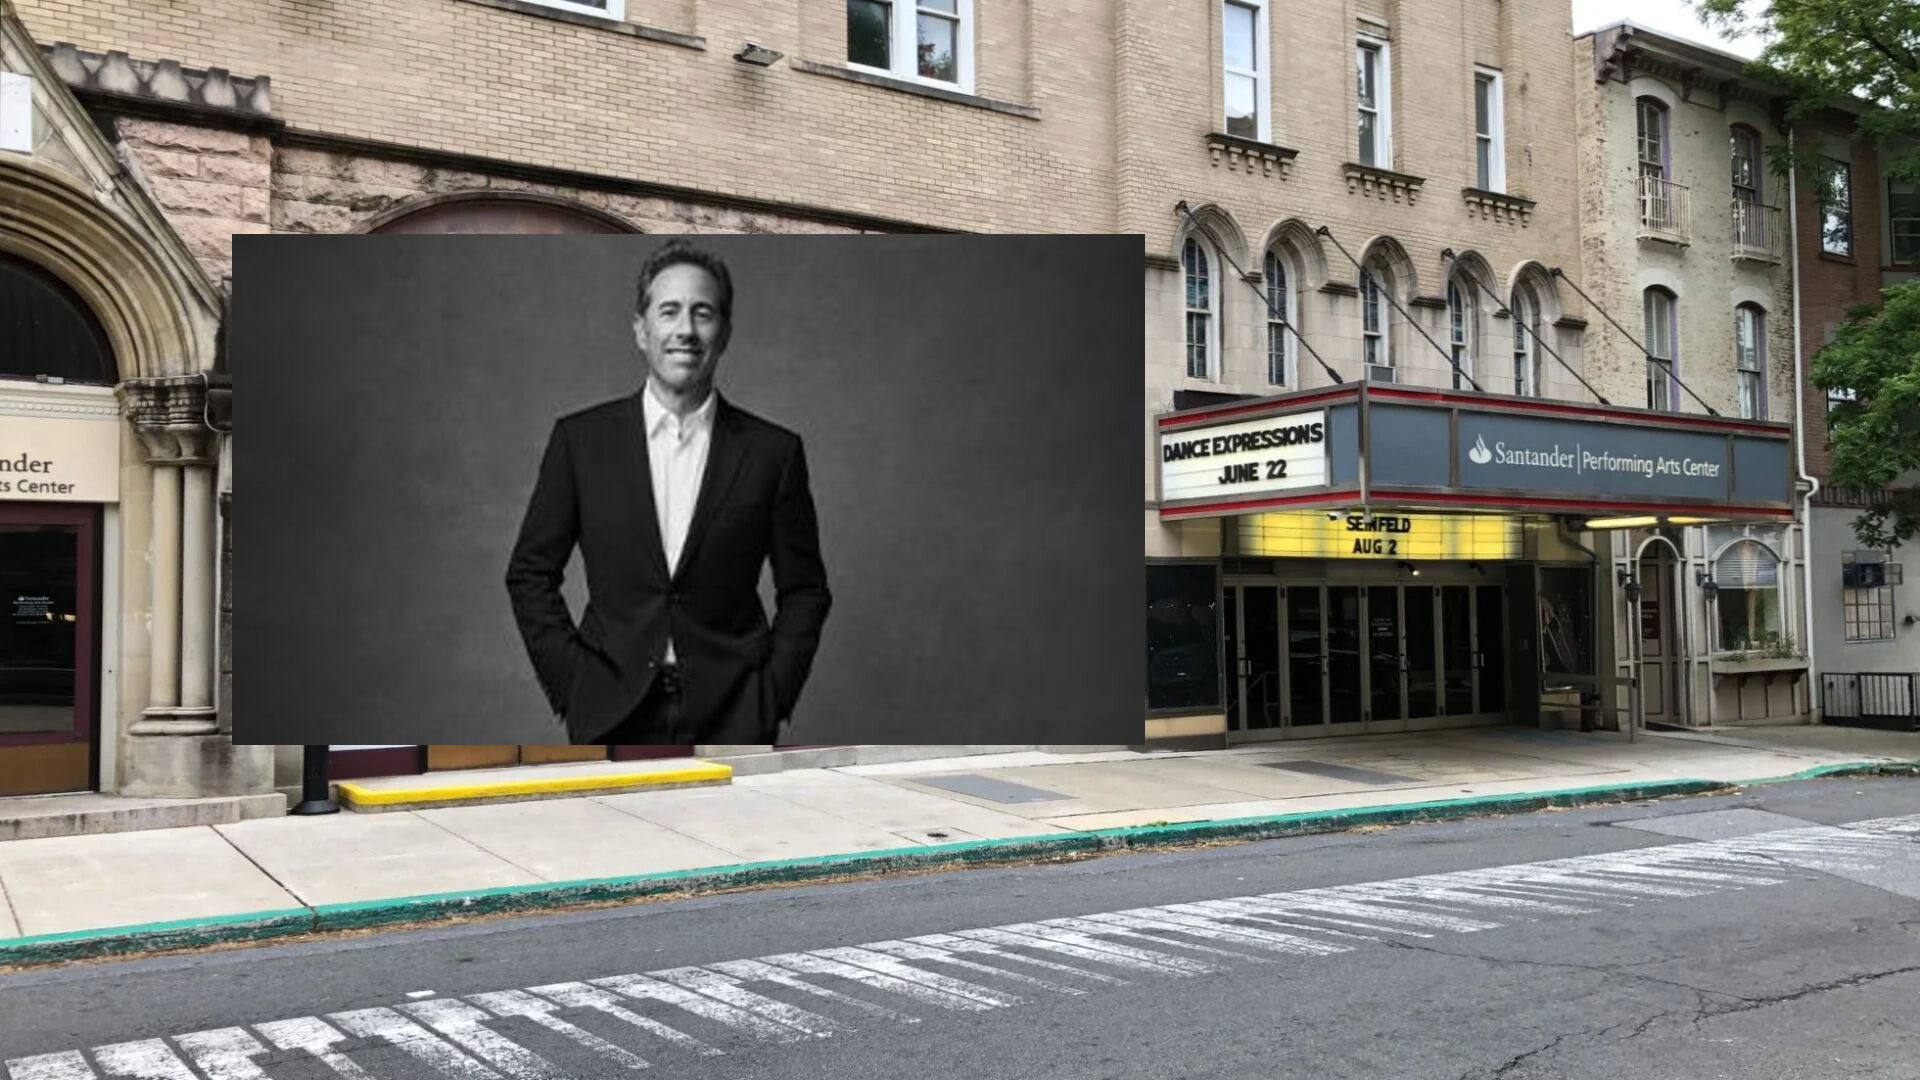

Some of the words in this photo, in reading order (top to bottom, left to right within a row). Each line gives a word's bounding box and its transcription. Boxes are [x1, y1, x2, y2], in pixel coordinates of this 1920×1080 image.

[1163, 438, 1211, 462] DANCE
[1212, 423, 1323, 455] EXPRESSIONS
[1218, 462, 1259, 484] JUNE
[1266, 459, 1287, 480] 22
[1495, 441, 1575, 468] Santander
[1582, 451, 1653, 478] Performing
[1656, 456, 1680, 475] Arts
[1683, 458, 1720, 477] Center
[17, 479, 75, 494] Center
[1352, 538, 1382, 554] AUG
[1388, 539, 1397, 555] 2
